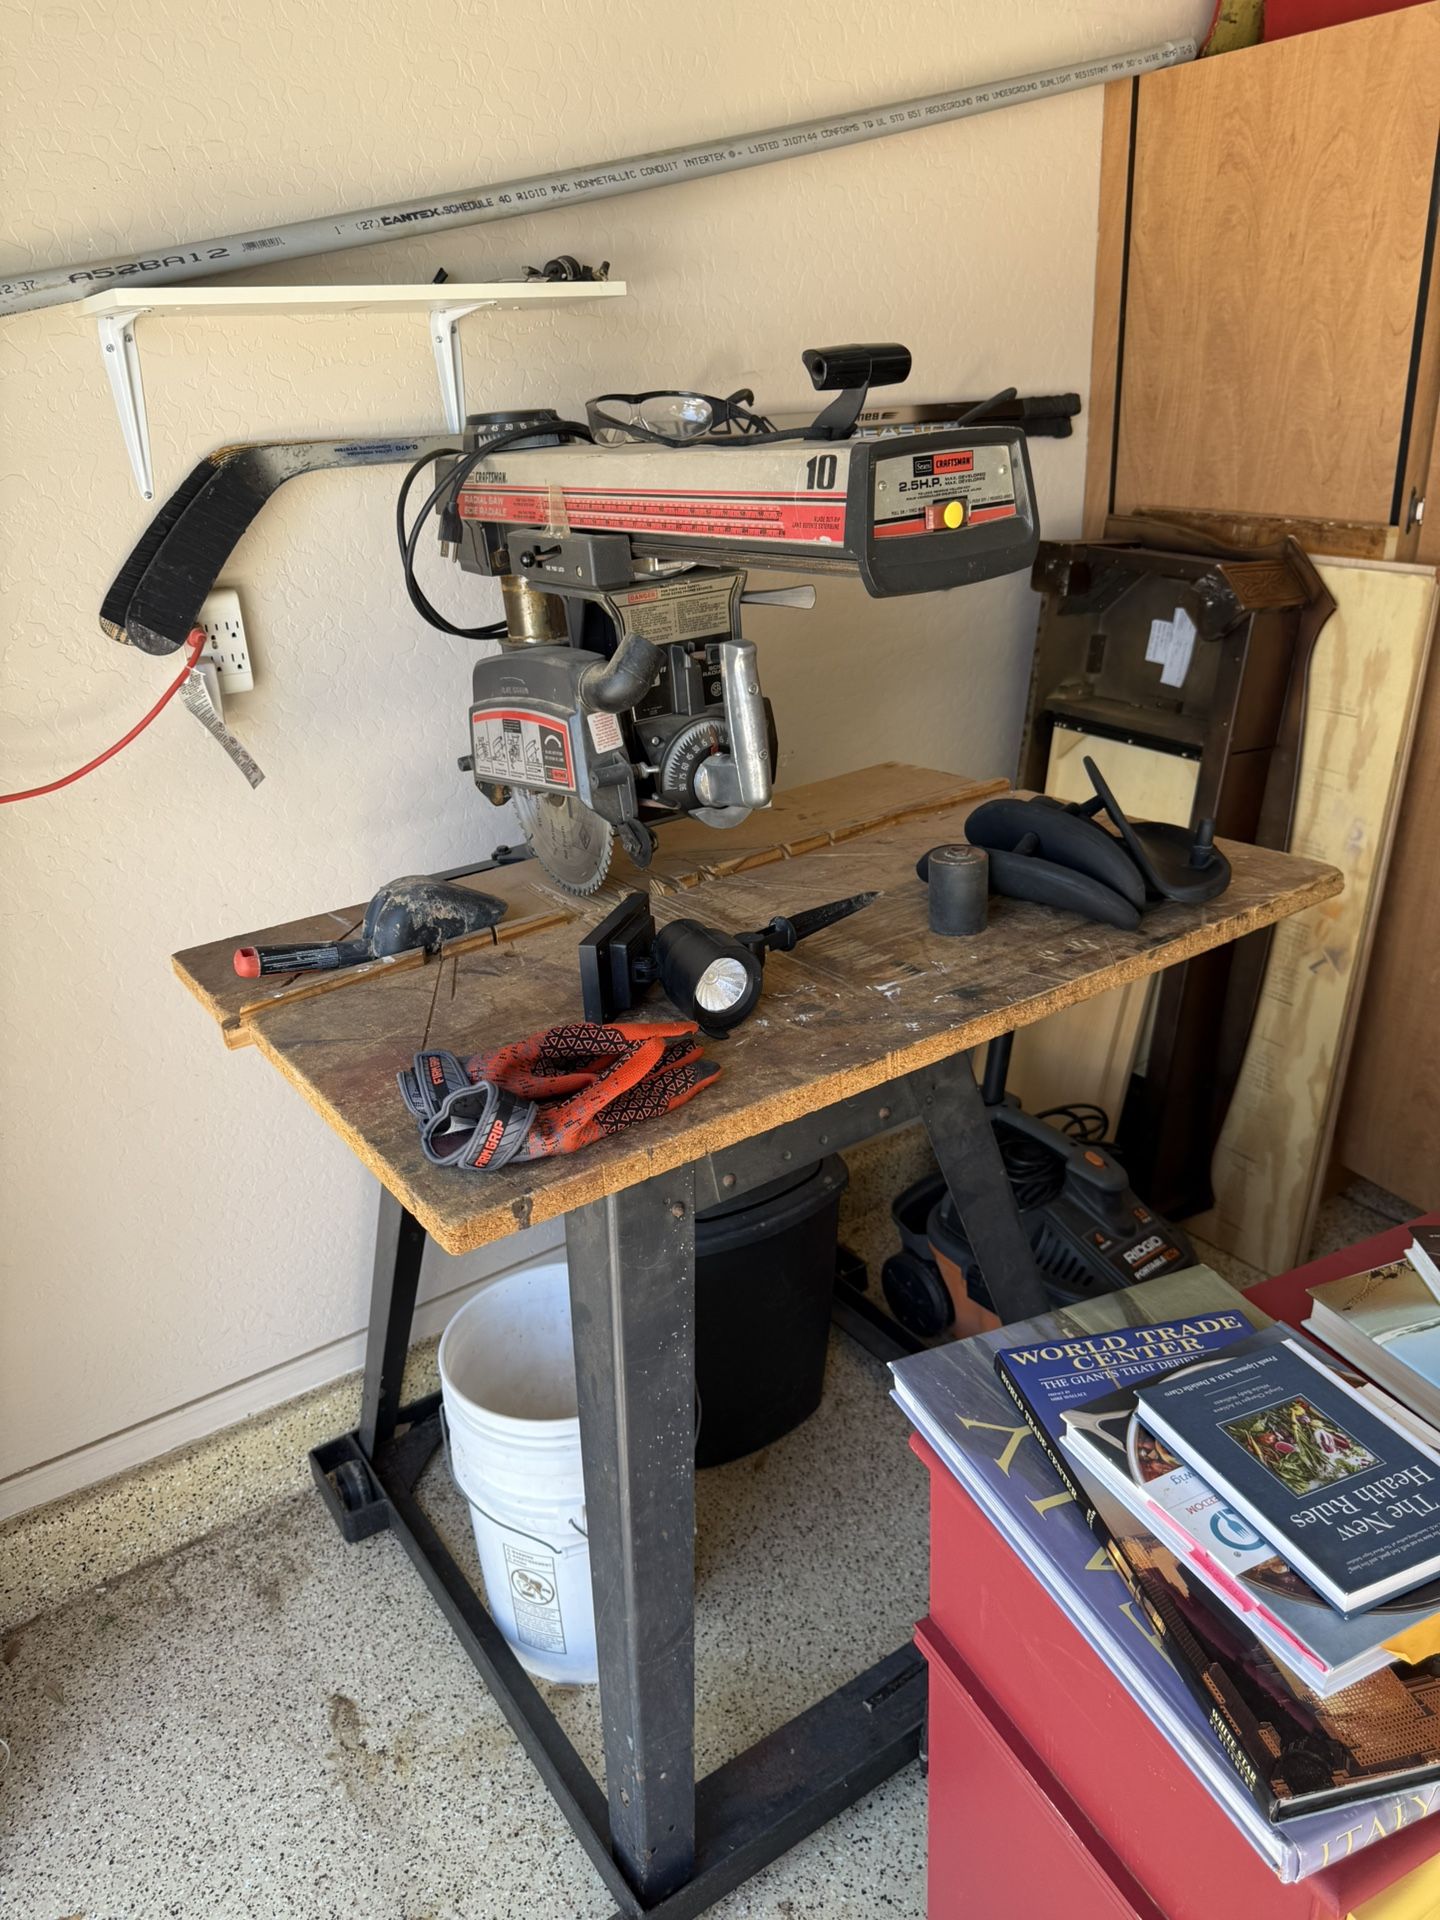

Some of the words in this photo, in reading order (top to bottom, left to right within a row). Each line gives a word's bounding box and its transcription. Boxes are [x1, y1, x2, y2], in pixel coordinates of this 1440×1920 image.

[69, 248, 230, 283] A52BA12
[443, 198, 494, 215] SCHEDULE
[498, 194, 512, 205] 40
[516, 187, 547, 201] RIGID
[551, 183, 570, 194] PVC
[574, 170, 637, 189] NONMETALLIC
[639, 161, 679, 177] CONDUIT
[684, 153, 726, 167] INTERTEK
[748, 140, 779, 154] LISTED
[783, 132, 817, 147] 3107144
[821, 124, 860, 139] CONFORMS
[864, 119, 874, 129] TO
[876, 117, 886, 126] UL
[890, 113, 905, 124] STD
[925, 97, 973, 115] ABOVEGROUND
[976, 94, 989, 103] AND
[991, 82, 1038, 100] UNDERGROUND
[1040, 74, 1071, 88] SUNLIGHT
[1074, 65, 1109, 80] RESISTANT
[476, 471, 507, 484] CRAFTSMAN
[806, 454, 838, 490] 10
[916, 460, 932, 471] Sears
[936, 456, 971, 469] CRAFTSMAN
[899, 477, 942, 492] 2.5H.P.
[630, 590, 657, 601] DANGER
[474, 1149, 494, 1168] FIRM
[485, 1119, 505, 1150] GRIP
[1123, 1235, 1163, 1265] RIDGID
[1009, 1335, 1127, 1366] WORLD
[1135, 1315, 1242, 1345] TRADE
[1072, 1337, 1204, 1370] CENTER
[1040, 1377, 1069, 1390] THE
[1073, 1368, 1118, 1386] GIANTS
[1119, 1362, 1156, 1378] THAT
[1215, 1371, 1231, 1382] M.D.
[1257, 1355, 1278, 1368] Frank
[1164, 1387, 1183, 1398] Claro
[1182, 1379, 1209, 1393] Danielle
[1001, 1371, 1024, 1412] WORLD
[1024, 1410, 1048, 1451] TRADE
[1047, 1449, 1077, 1500] CENTER
[1170, 1471, 1196, 1485] wig
[1352, 1464, 1436, 1505] Health
[1290, 1494, 1362, 1528] Rules
[1386, 1493, 1440, 1519] The
[1336, 1510, 1396, 1541] New
[1212, 1708, 1237, 1750] WHITE
[1238, 1750, 1257, 1784] STAR
[1320, 1783, 1440, 1868] ITALY
